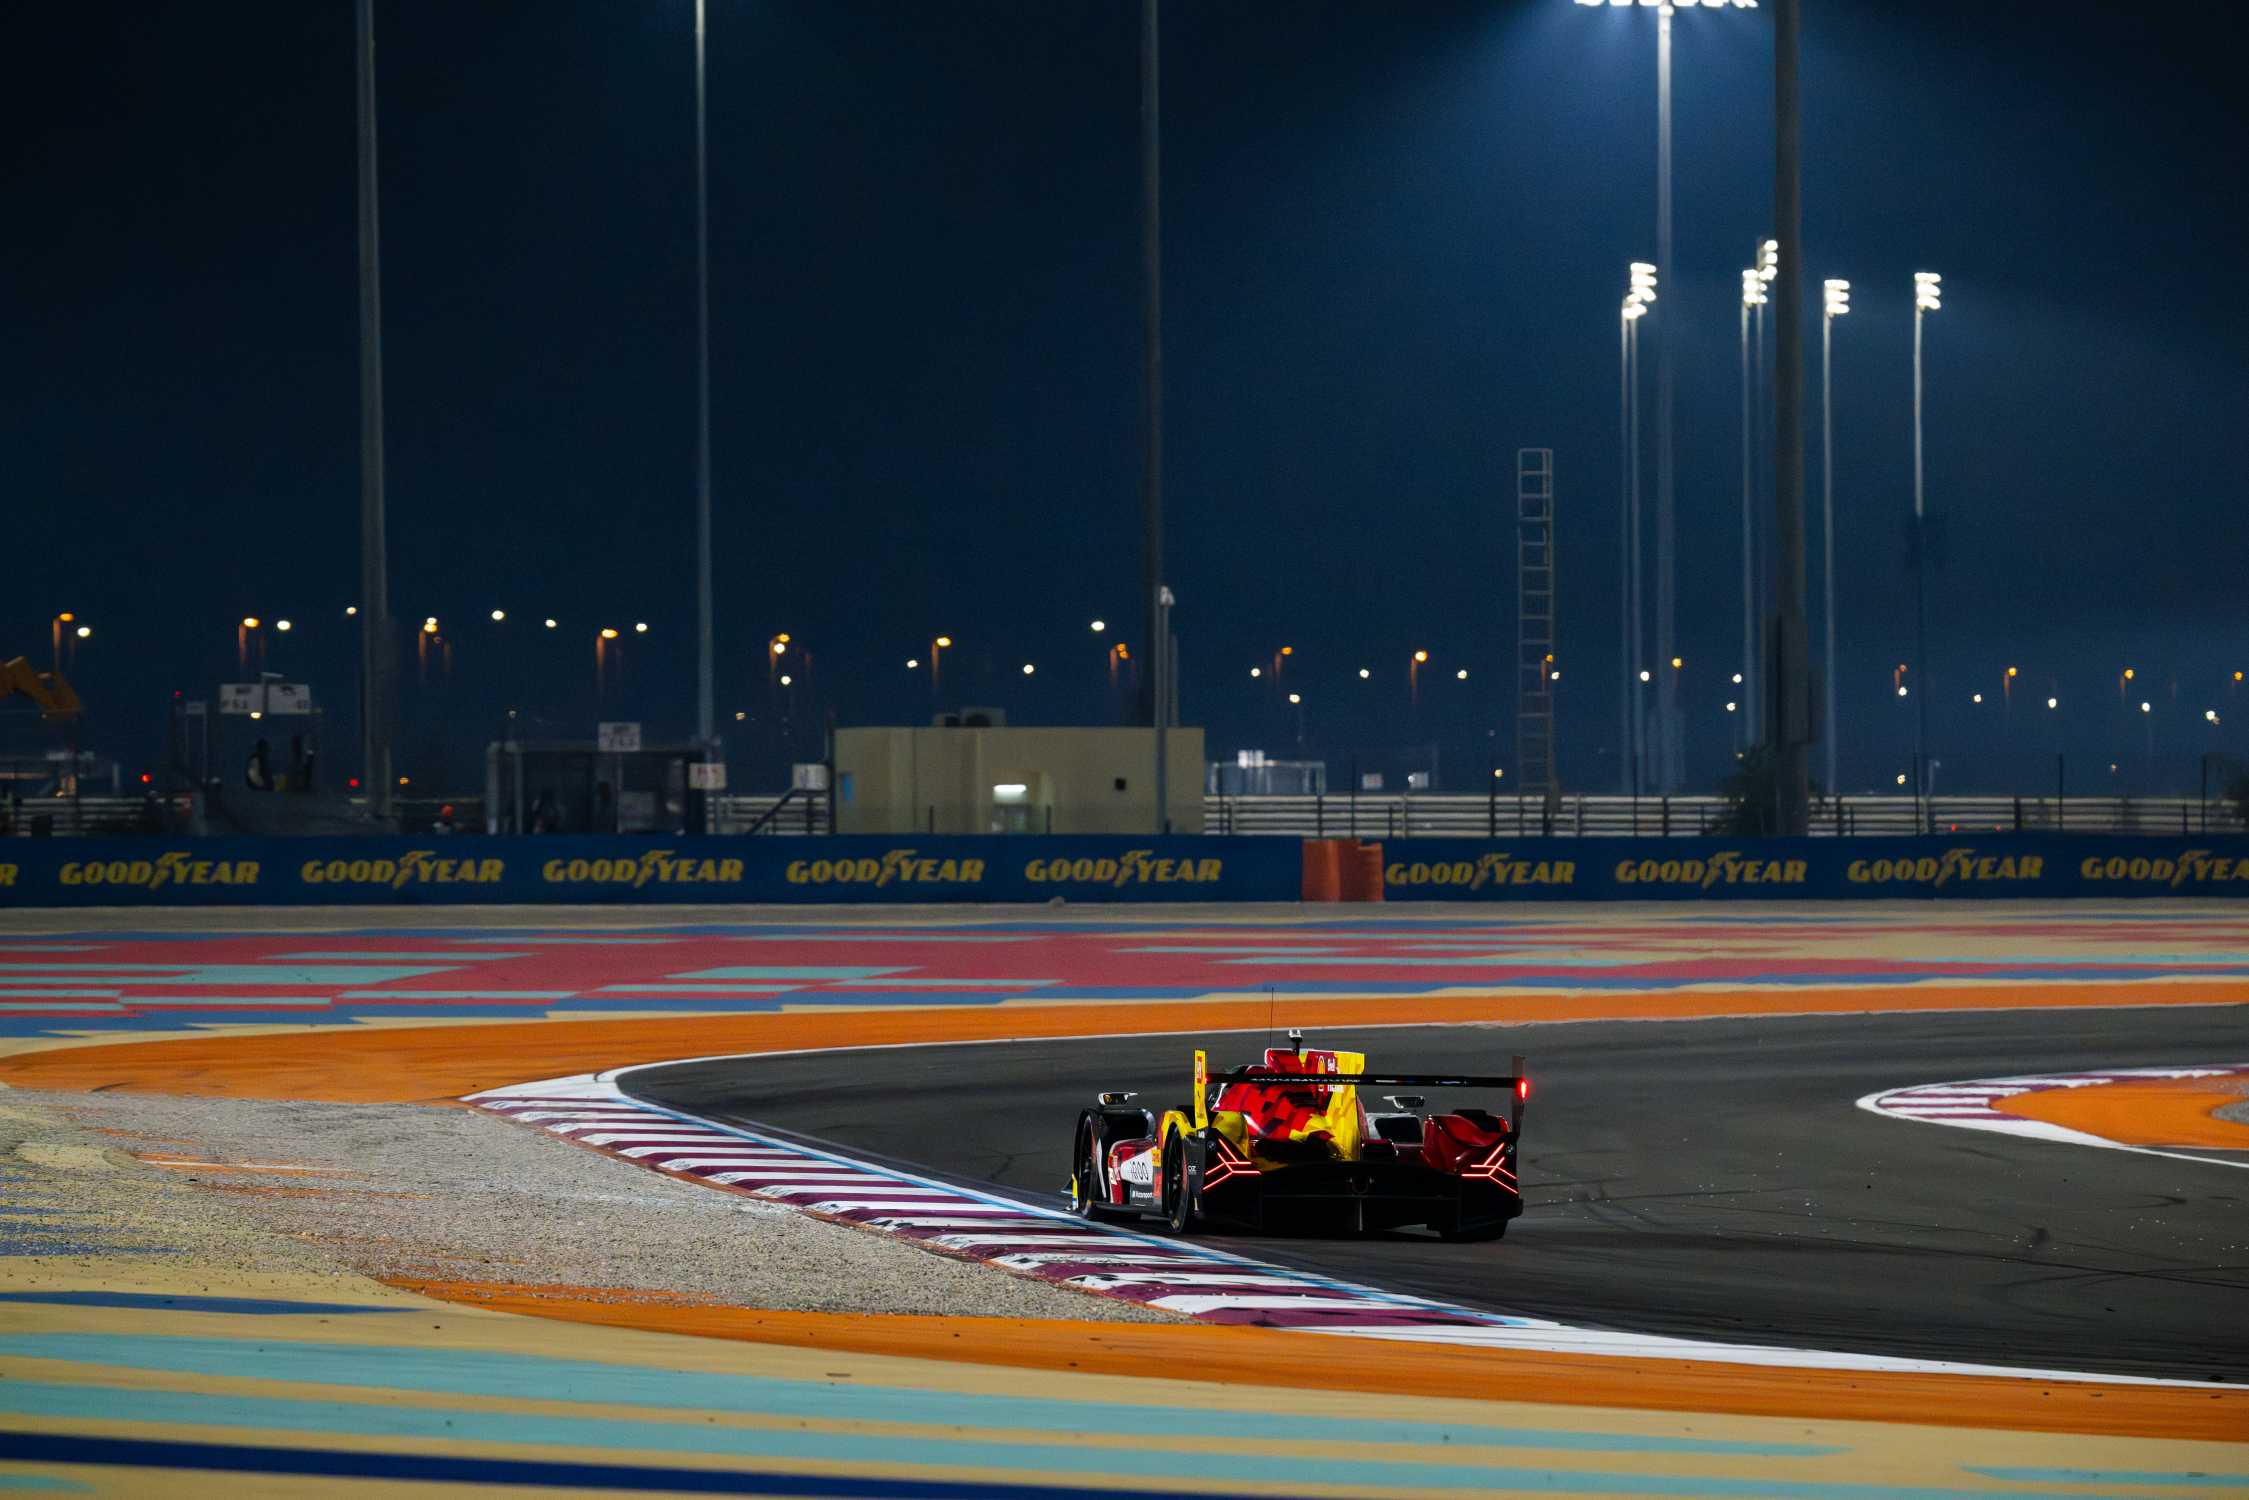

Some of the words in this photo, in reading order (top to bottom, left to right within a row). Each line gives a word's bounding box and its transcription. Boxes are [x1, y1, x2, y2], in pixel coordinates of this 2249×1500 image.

[60, 855, 260, 887] GOODYEAR
[301, 854, 504, 887] GOODYEAR
[542, 853, 744, 887] GOODYEAR
[785, 853, 985, 886] GOODYEAR
[1025, 852, 1222, 886] GOODYEAR
[1386, 857, 1576, 887] GOODYEAR
[1614, 855, 1808, 887] GOODYEAR
[1847, 852, 2044, 886] GOODYEAR
